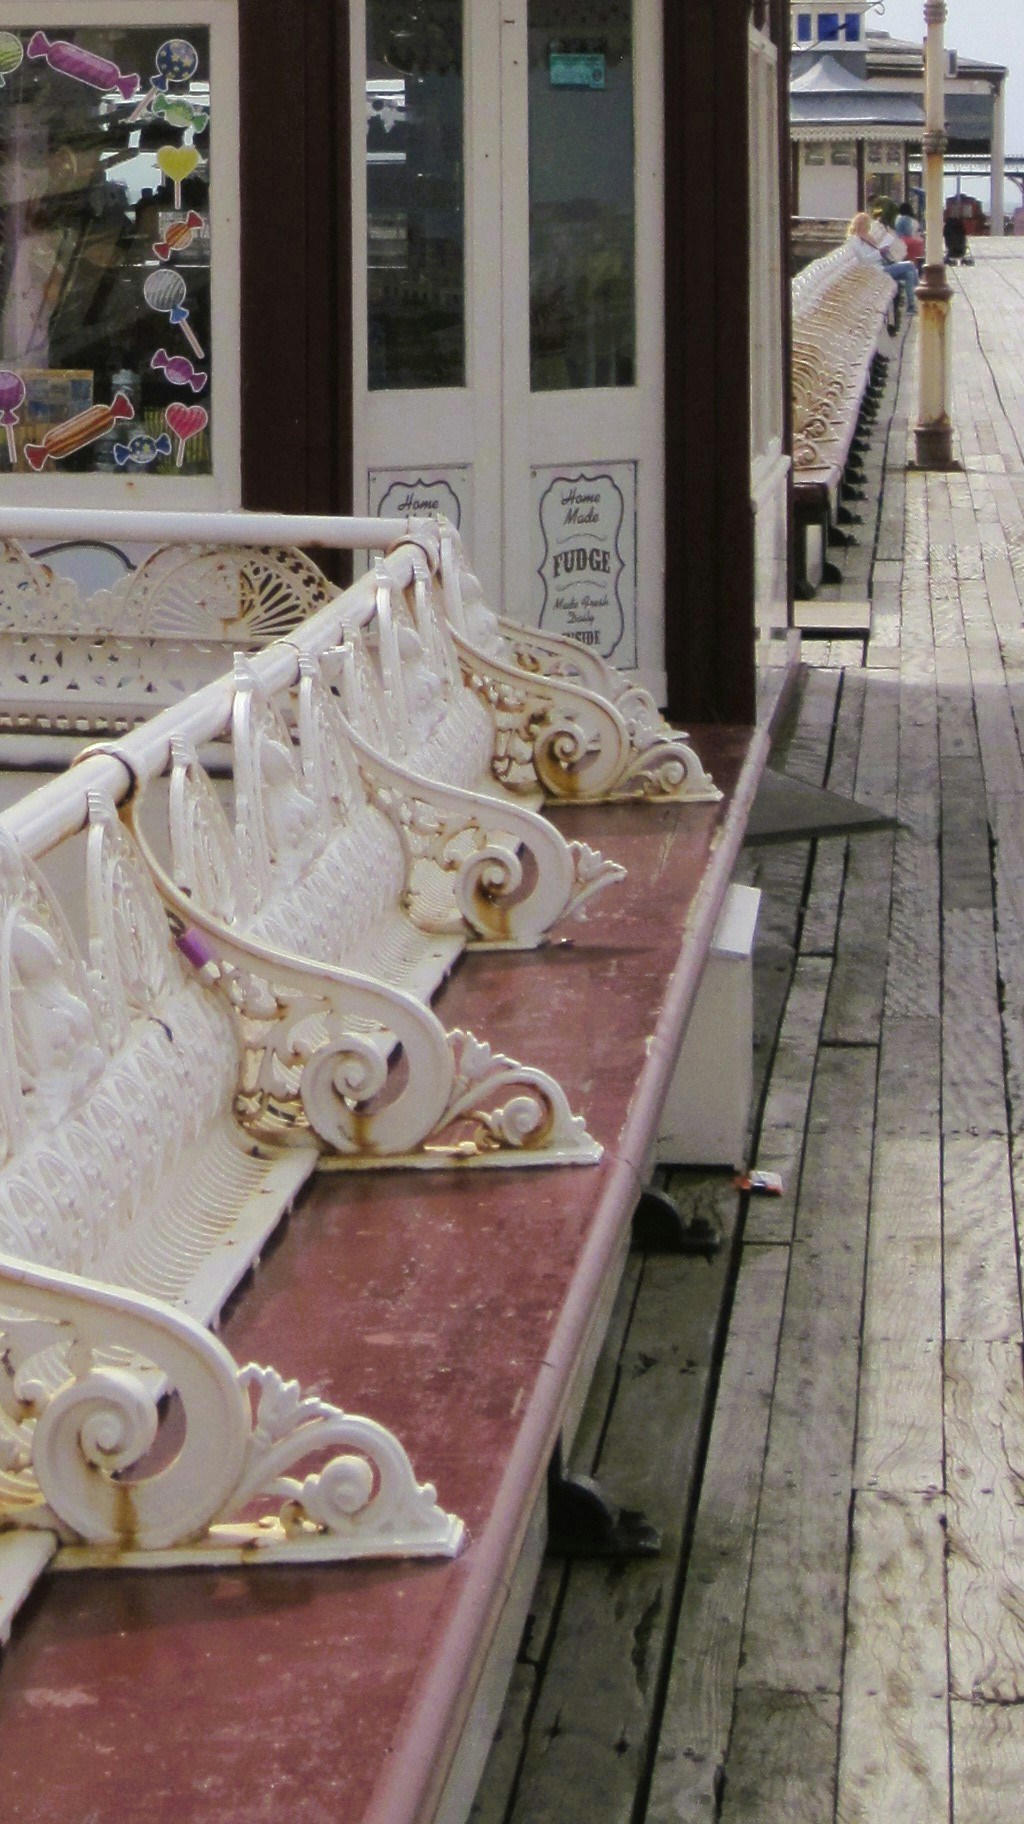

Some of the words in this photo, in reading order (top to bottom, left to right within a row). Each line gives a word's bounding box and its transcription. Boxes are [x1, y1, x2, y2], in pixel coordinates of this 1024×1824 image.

[397, 492, 438, 511] Home
[561, 488, 601, 506] Home
[563, 508, 600, 526] Made
[553, 547, 611, 578] FUDGE
